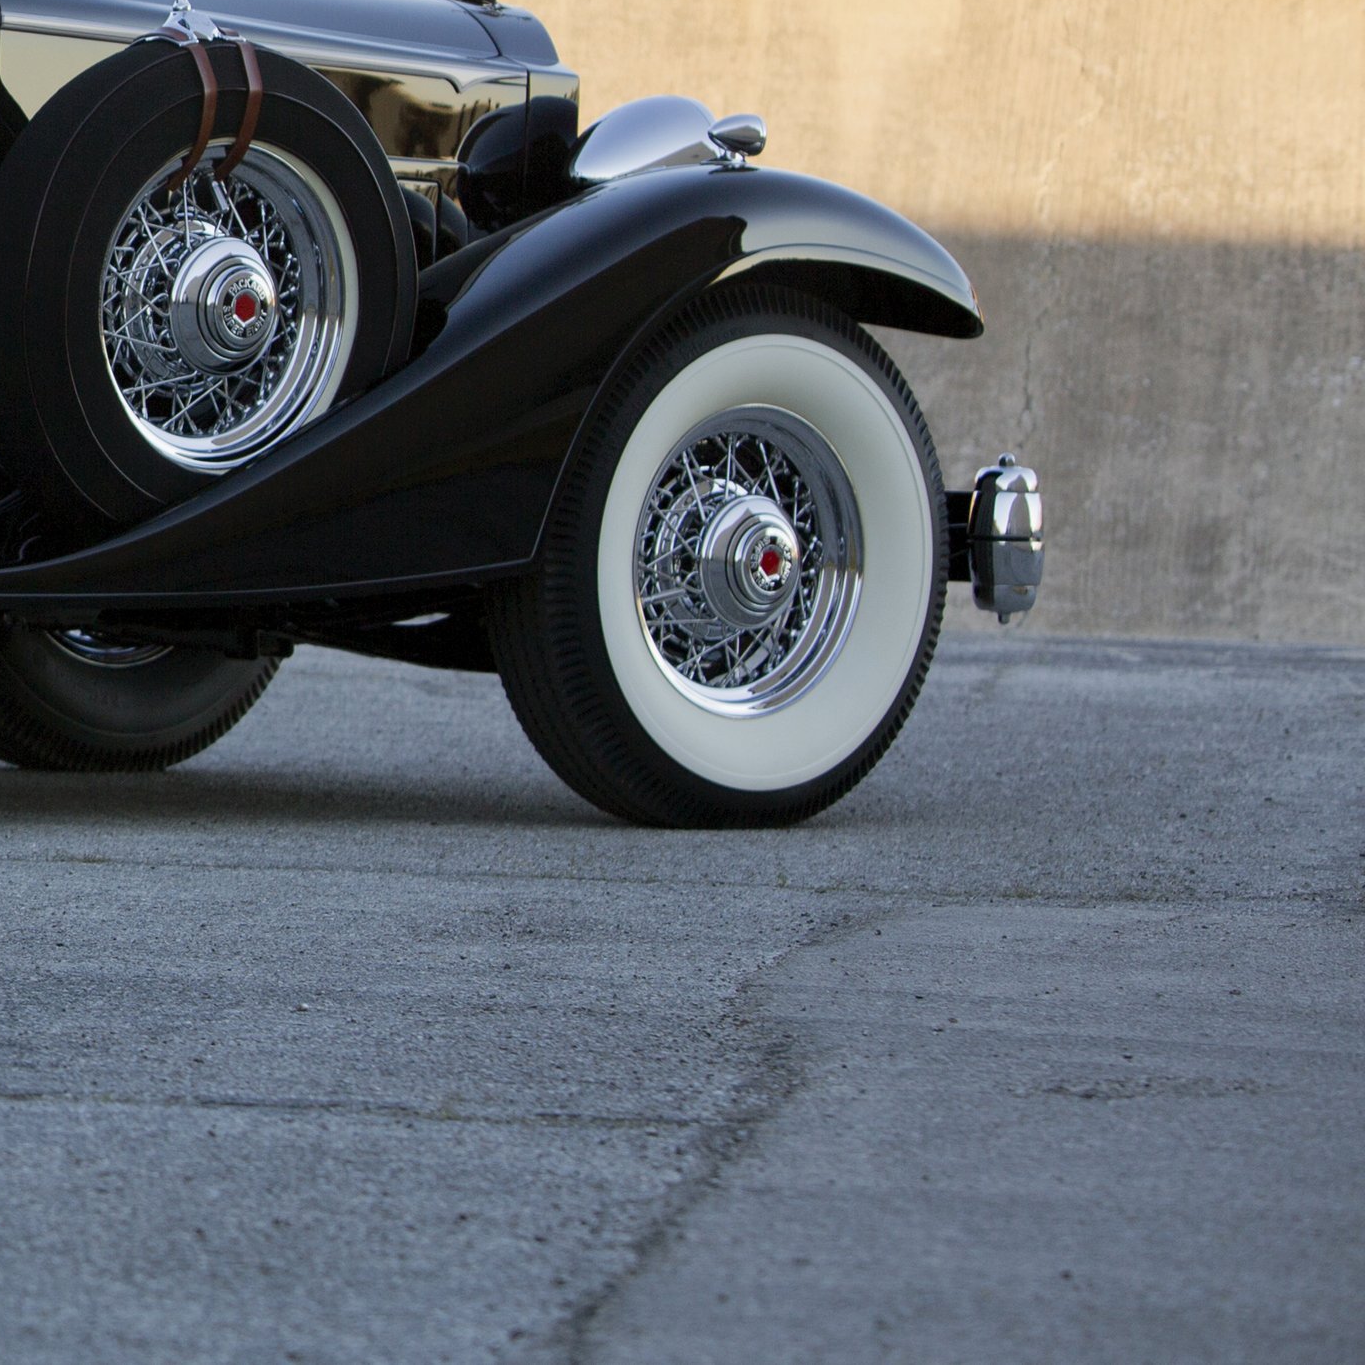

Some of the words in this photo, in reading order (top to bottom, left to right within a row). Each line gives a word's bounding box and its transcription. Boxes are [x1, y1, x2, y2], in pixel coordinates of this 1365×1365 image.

[229, 278, 266, 301] PACKARD
[222, 305, 245, 337] SUPER
[246, 309, 267, 337] EIGHT
